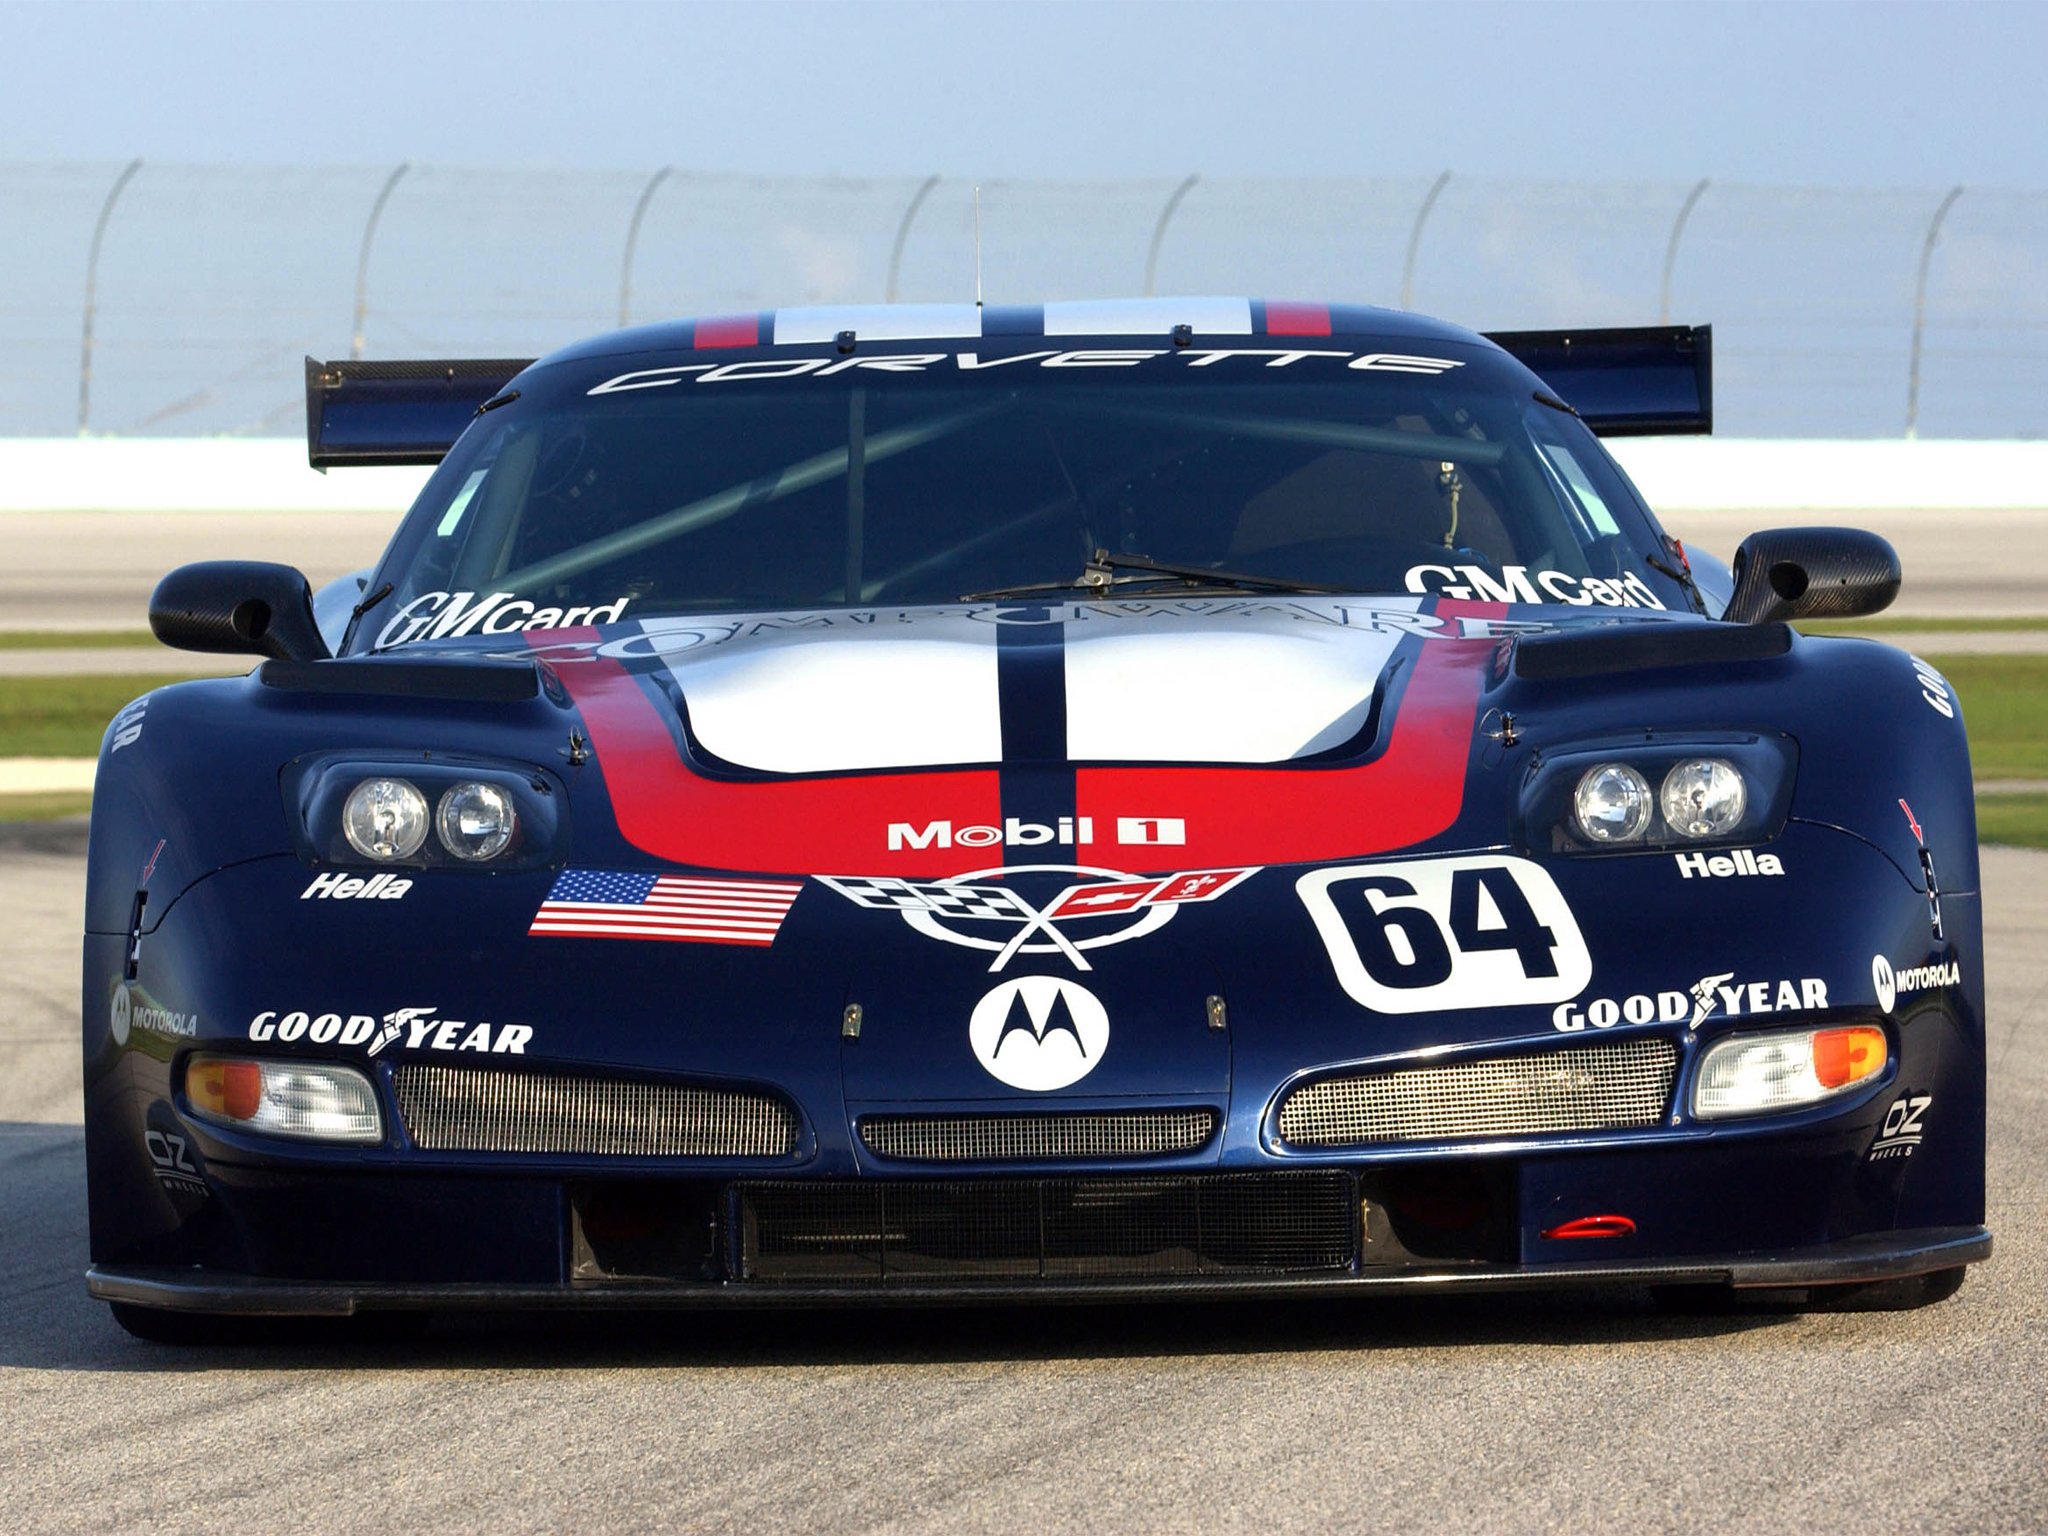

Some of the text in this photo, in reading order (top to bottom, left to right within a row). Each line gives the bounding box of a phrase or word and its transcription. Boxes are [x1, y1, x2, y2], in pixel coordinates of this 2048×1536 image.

[587, 349, 1466, 395] CORVETTE
[887, 816, 1094, 851] Mobil
[1674, 849, 1785, 879] Hella
[300, 872, 414, 900] Hella
[1326, 866, 1559, 990] 64
[1895, 960, 1961, 993] MOTOROLA
[132, 1005, 198, 1037] MOTOROLA
[1882, 1095, 1933, 1138] OZ
[145, 1130, 197, 1174] OZ
